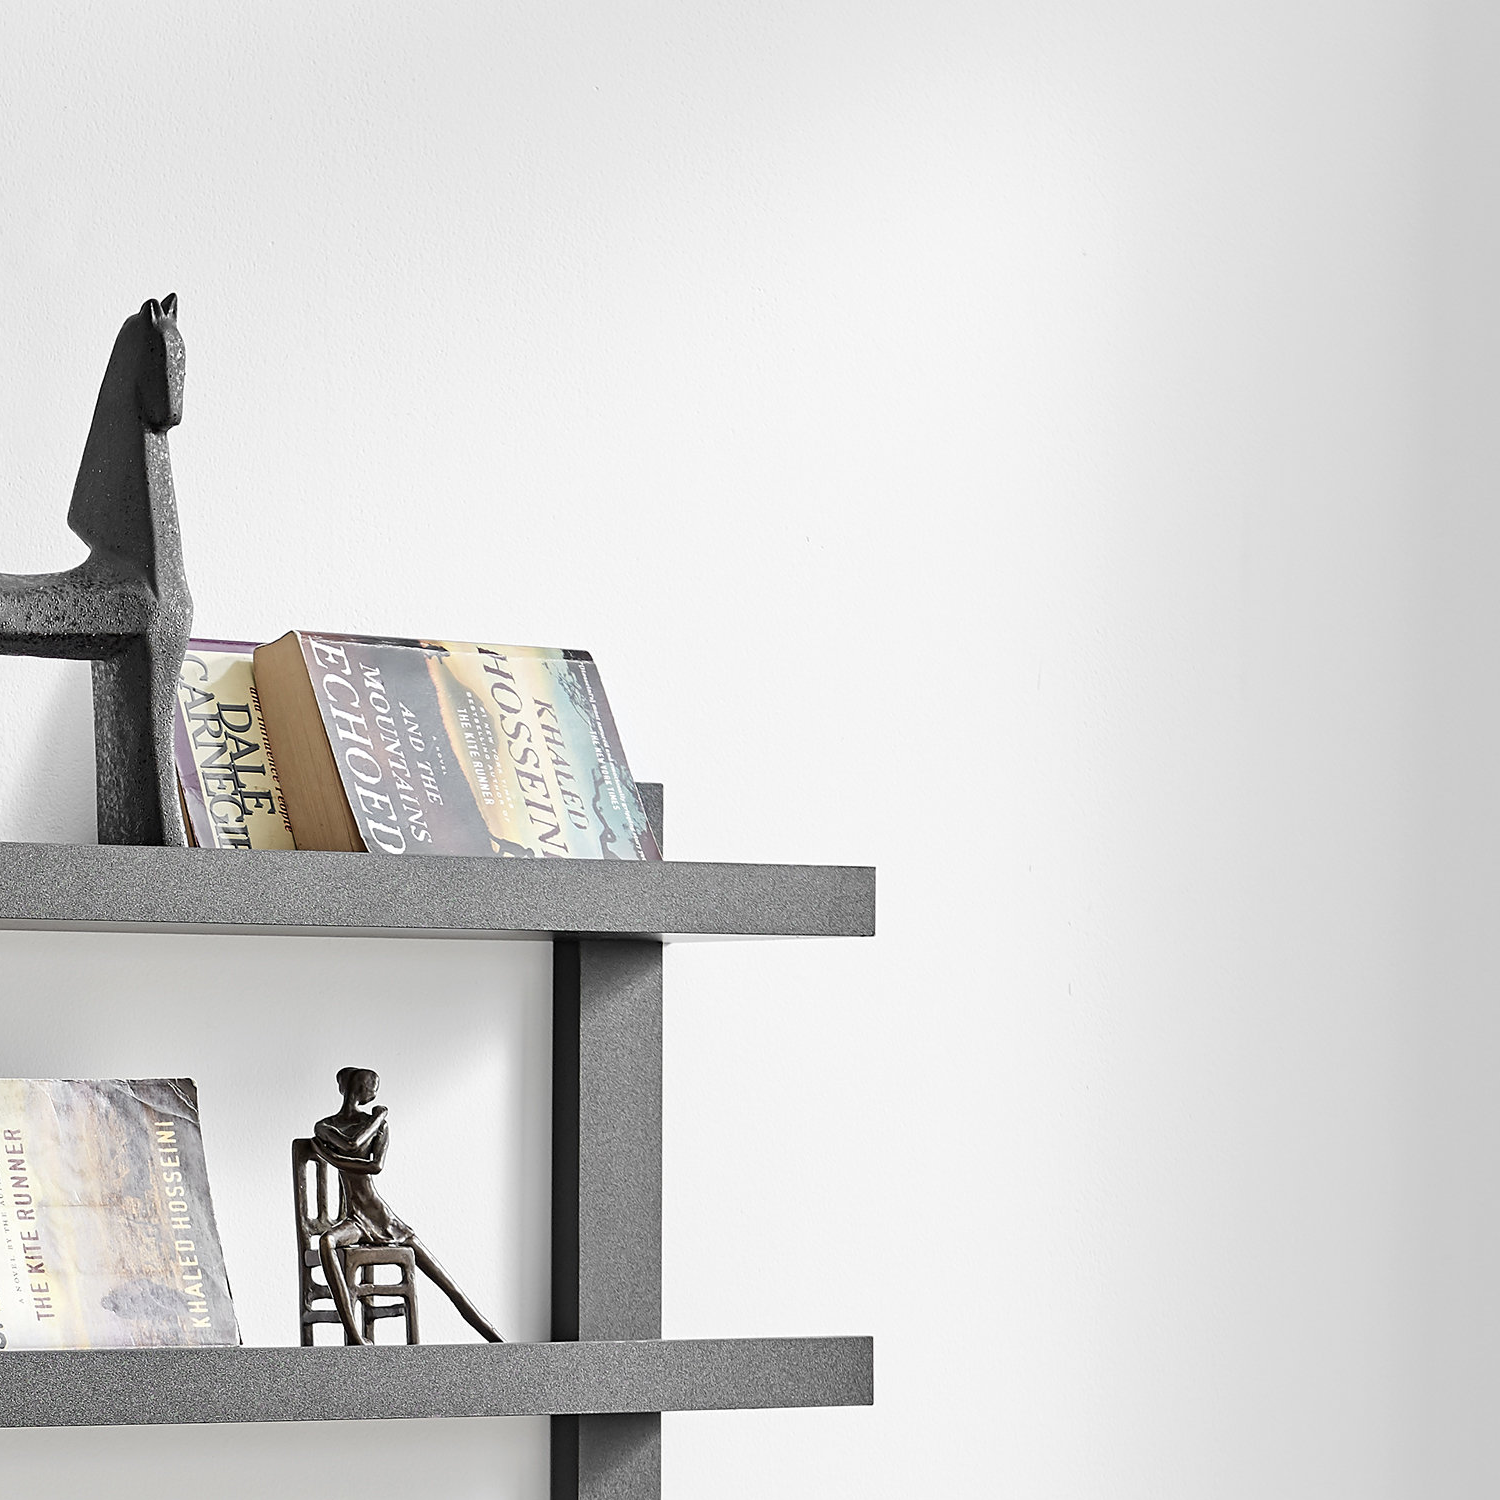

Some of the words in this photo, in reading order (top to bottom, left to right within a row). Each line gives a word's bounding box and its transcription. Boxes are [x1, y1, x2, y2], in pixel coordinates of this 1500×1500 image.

[456, 707, 472, 730] THE
[589, 730, 600, 745] THE
[216, 702, 276, 816] DALE
[308, 635, 407, 855] ECHOED
[359, 662, 433, 844] MOUNTAINS
[398, 701, 425, 752] AND
[416, 760, 444, 806] THE
[435, 746, 447, 775] NOVEL
[463, 730, 480, 759] KITE
[483, 722, 494, 745] NEW
[491, 748, 503, 774] YORK
[500, 778, 514, 809] TIMES
[532, 696, 590, 830] KHALED
[594, 747, 606, 765] NEW
[472, 758, 495, 806] RUNNER
[487, 762, 504, 806] AUTHOR
[501, 809, 510, 823] OF
[599, 764, 612, 786] YORK
[606, 786, 621, 811] TIMES
[3, 1128, 36, 1220] RUNNER
[154, 1121, 192, 1229] HOSSEINI
[1, 1211, 10, 1233] THE
[6, 1238, 13, 1251] BY
[20, 1229, 46, 1274] KITE
[10, 1257, 22, 1292] NOVEL
[175, 1239, 212, 1328] KHALED
[30, 1282, 55, 1321] THE
